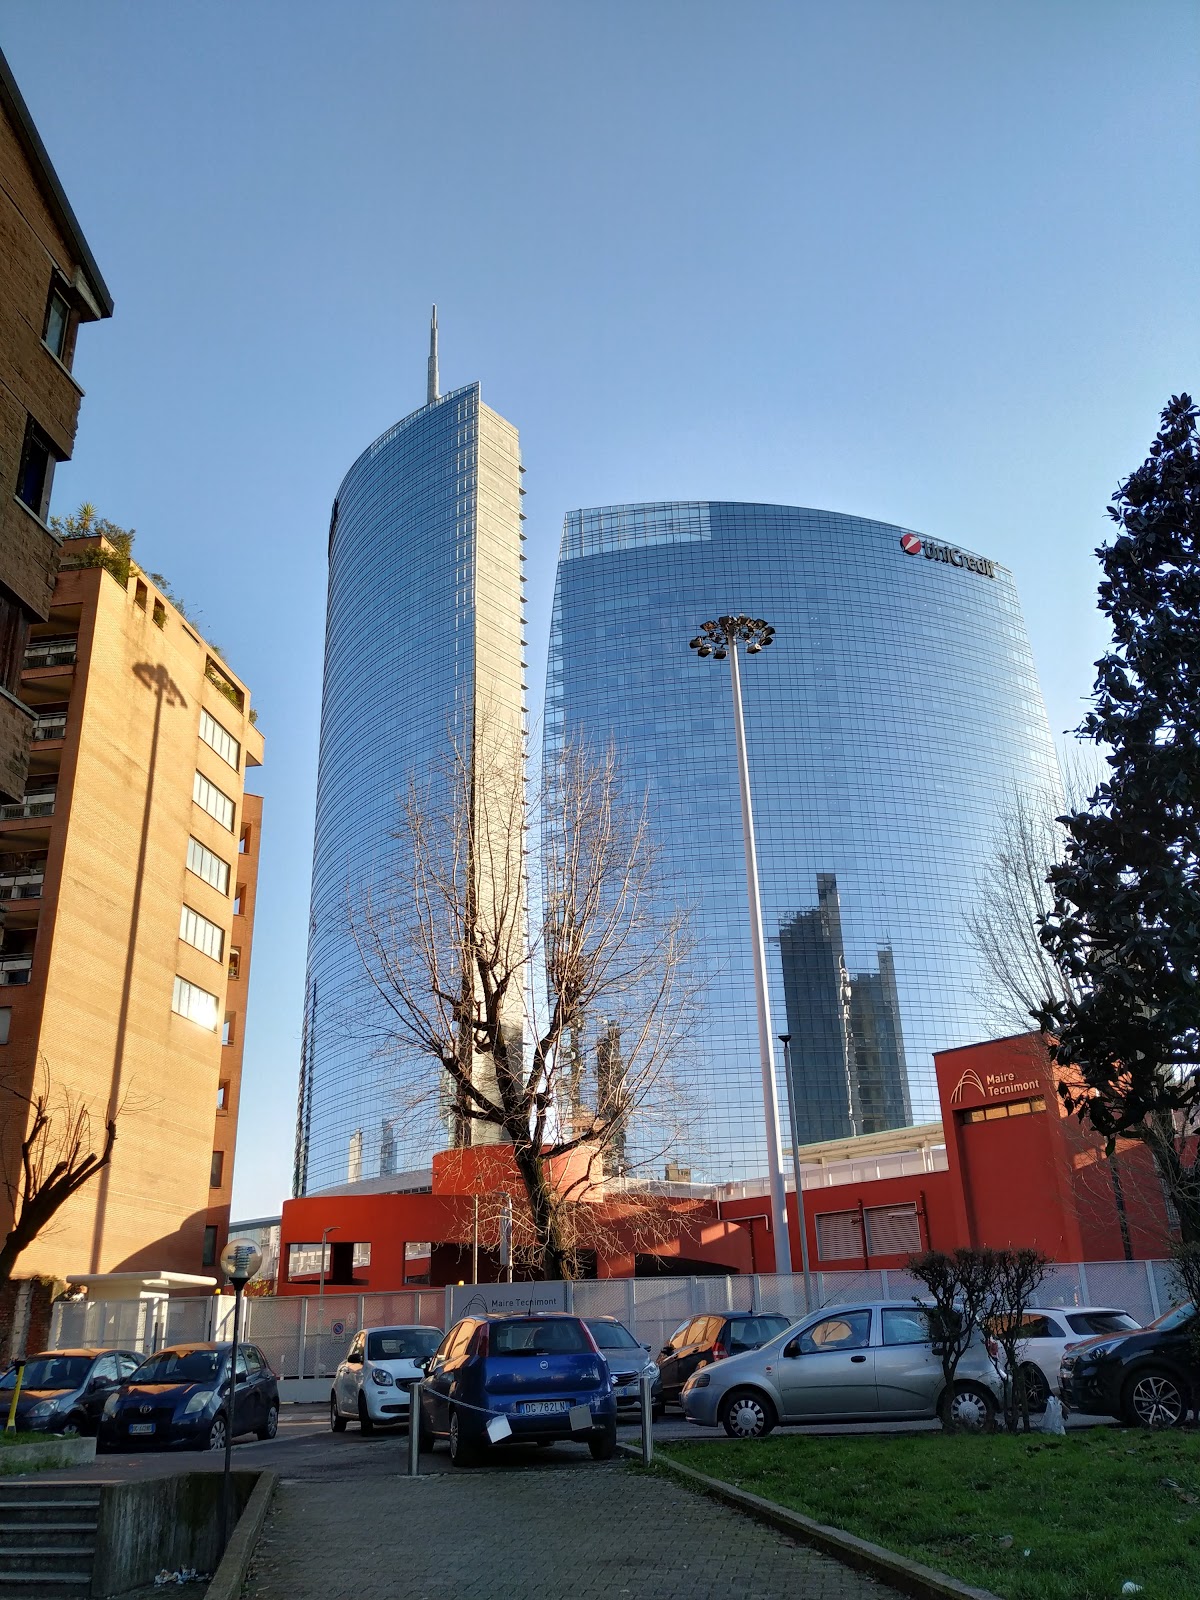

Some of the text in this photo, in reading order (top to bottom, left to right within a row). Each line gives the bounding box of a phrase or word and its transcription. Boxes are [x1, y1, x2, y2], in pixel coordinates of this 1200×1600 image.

[922, 540, 995, 578] UniCredit
[986, 1072, 1015, 1085] Maire
[988, 1079, 1040, 1097] Tecnimont
[491, 1299, 514, 1308] Maire
[539, 1401, 565, 1413] 782LN
